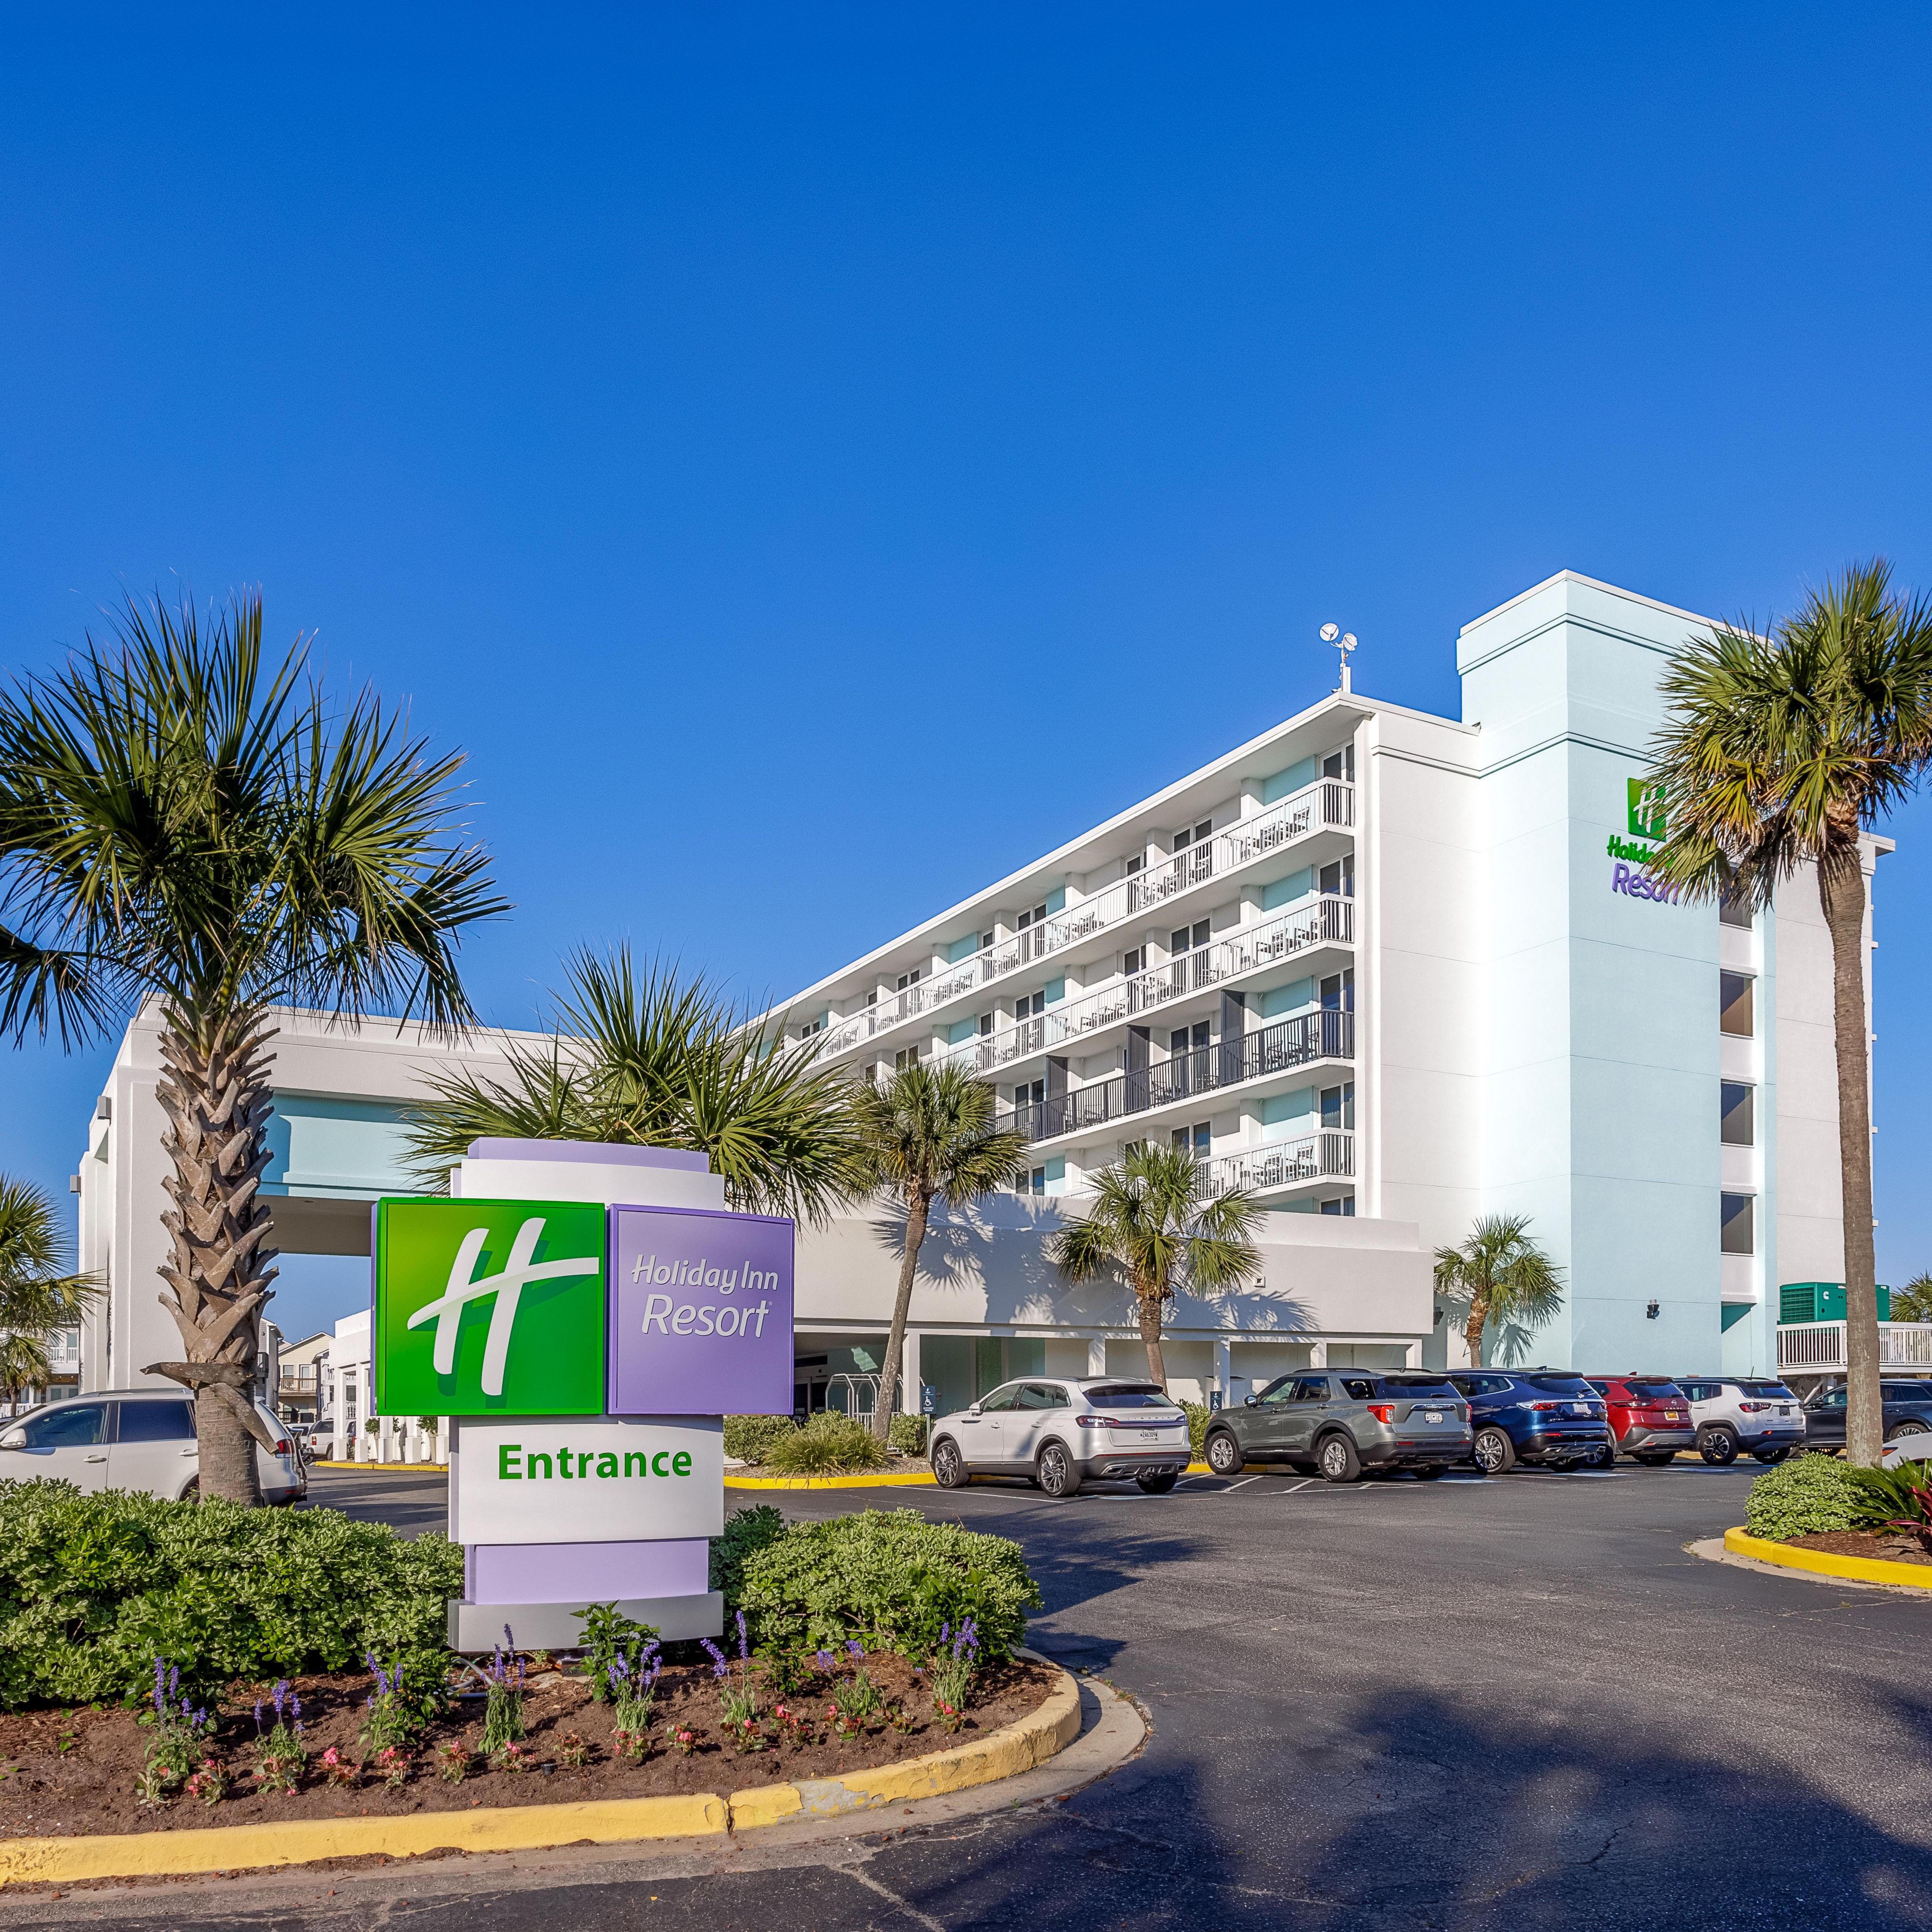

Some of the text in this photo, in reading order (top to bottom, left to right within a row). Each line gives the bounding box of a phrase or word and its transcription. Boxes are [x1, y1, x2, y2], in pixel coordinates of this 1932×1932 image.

[631, 1254, 779, 1295] Holiday Inn
[641, 1293, 769, 1338] Resort
[499, 1445, 692, 1479] Entrance
